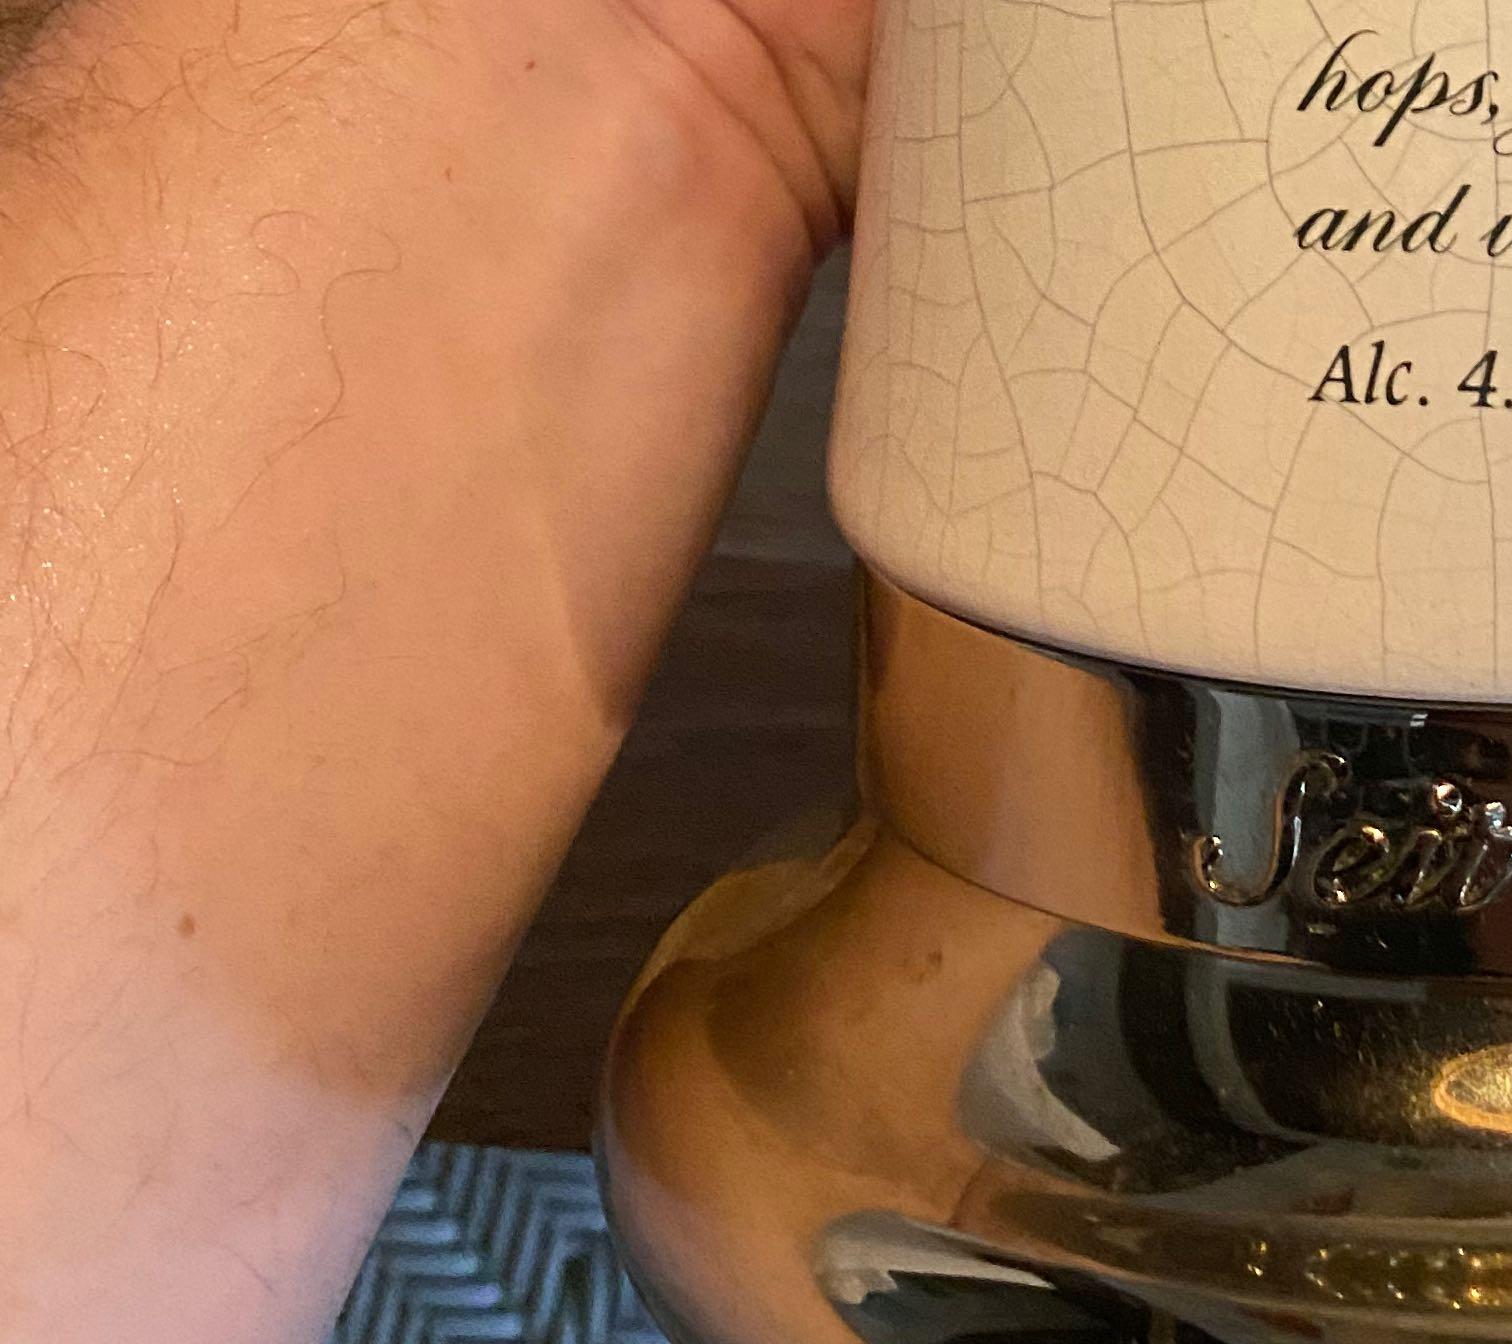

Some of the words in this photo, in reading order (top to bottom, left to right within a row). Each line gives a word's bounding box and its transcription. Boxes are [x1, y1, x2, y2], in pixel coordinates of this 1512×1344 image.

[1296, 28, 1500, 148] hops,
[1293, 183, 1472, 254] and
[1307, 340, 1429, 407] Alc.
